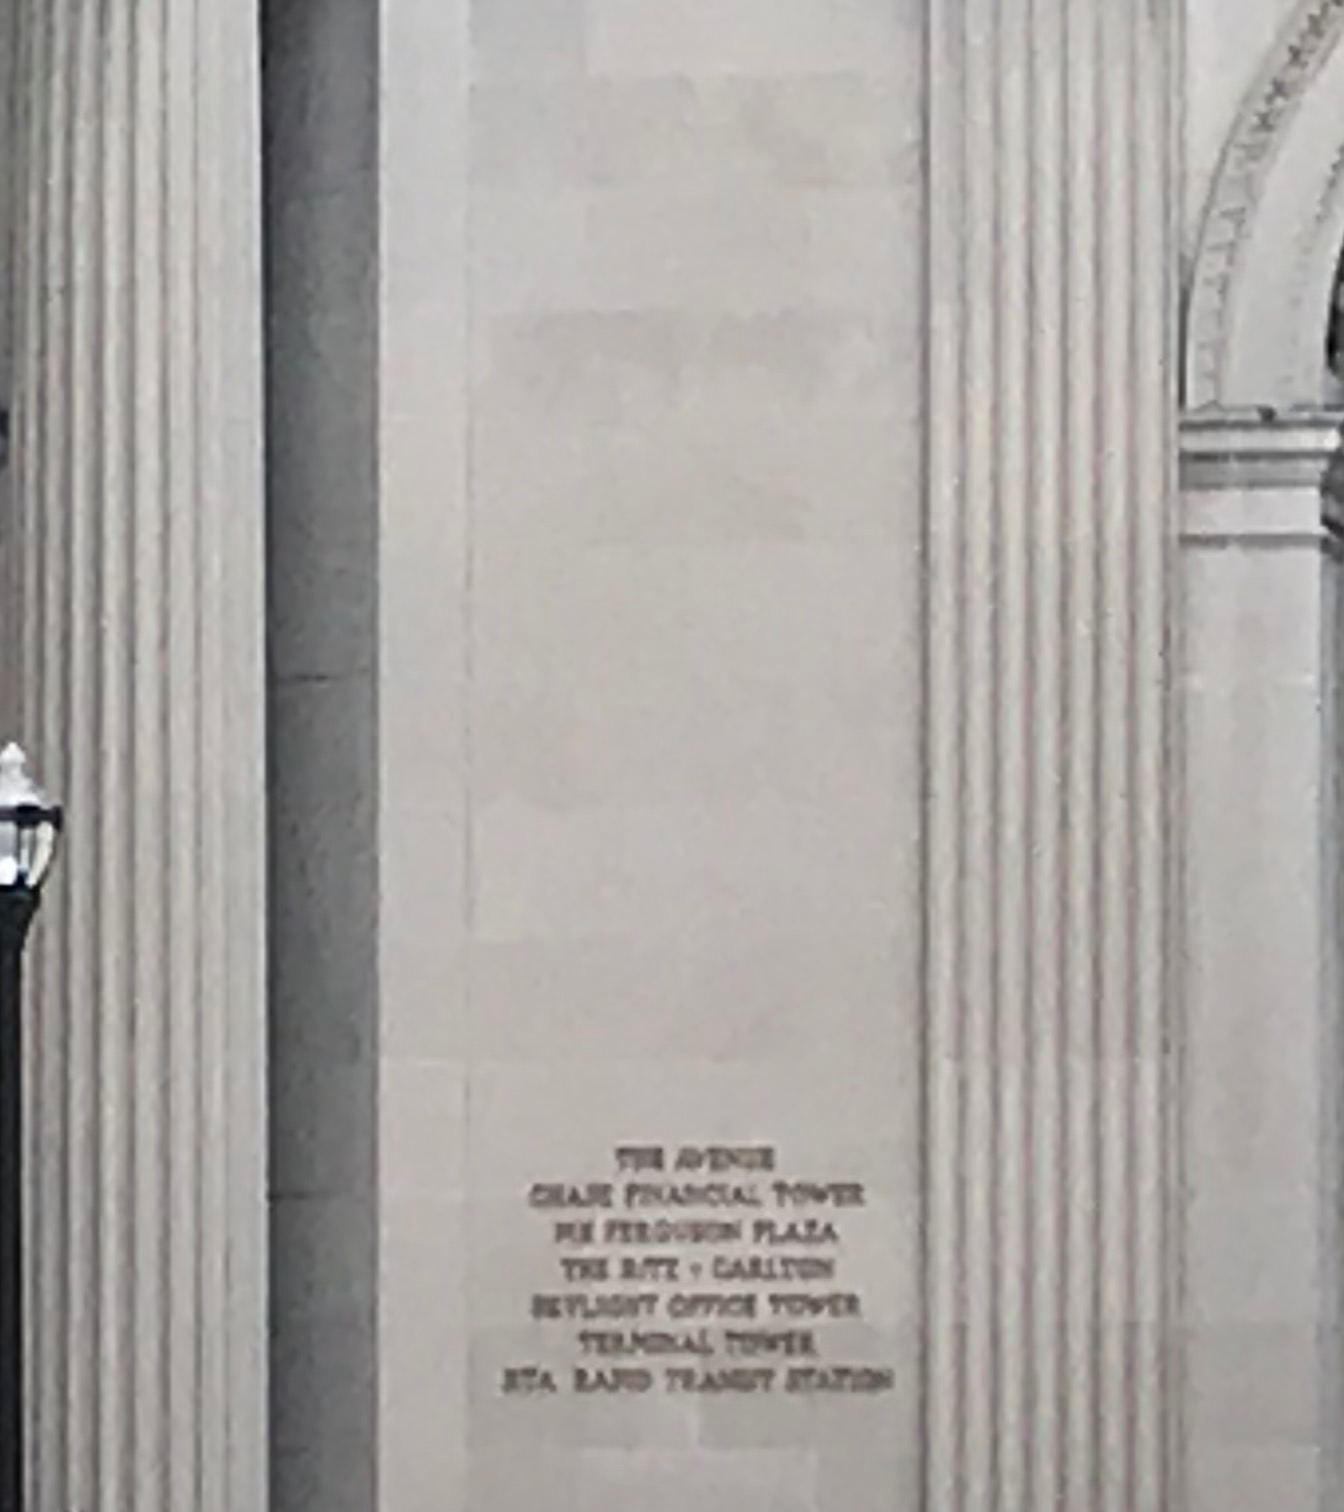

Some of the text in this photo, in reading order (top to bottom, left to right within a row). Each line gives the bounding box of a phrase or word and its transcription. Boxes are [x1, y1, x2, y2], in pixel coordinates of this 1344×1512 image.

[614, 1146, 665, 1172] THE
[771, 1181, 865, 1208] TOWER
[752, 1219, 839, 1245] PLAZA
[560, 1257, 609, 1282] THE
[668, 1293, 757, 1318] OFFICE
[768, 1293, 860, 1318] TOWER
[578, 1330, 817, 1356] TERMINAL TOWER
[573, 1367, 653, 1393] RAPID
[665, 1367, 776, 1393] TRANSIT
[785, 1366, 894, 1394] STATION
